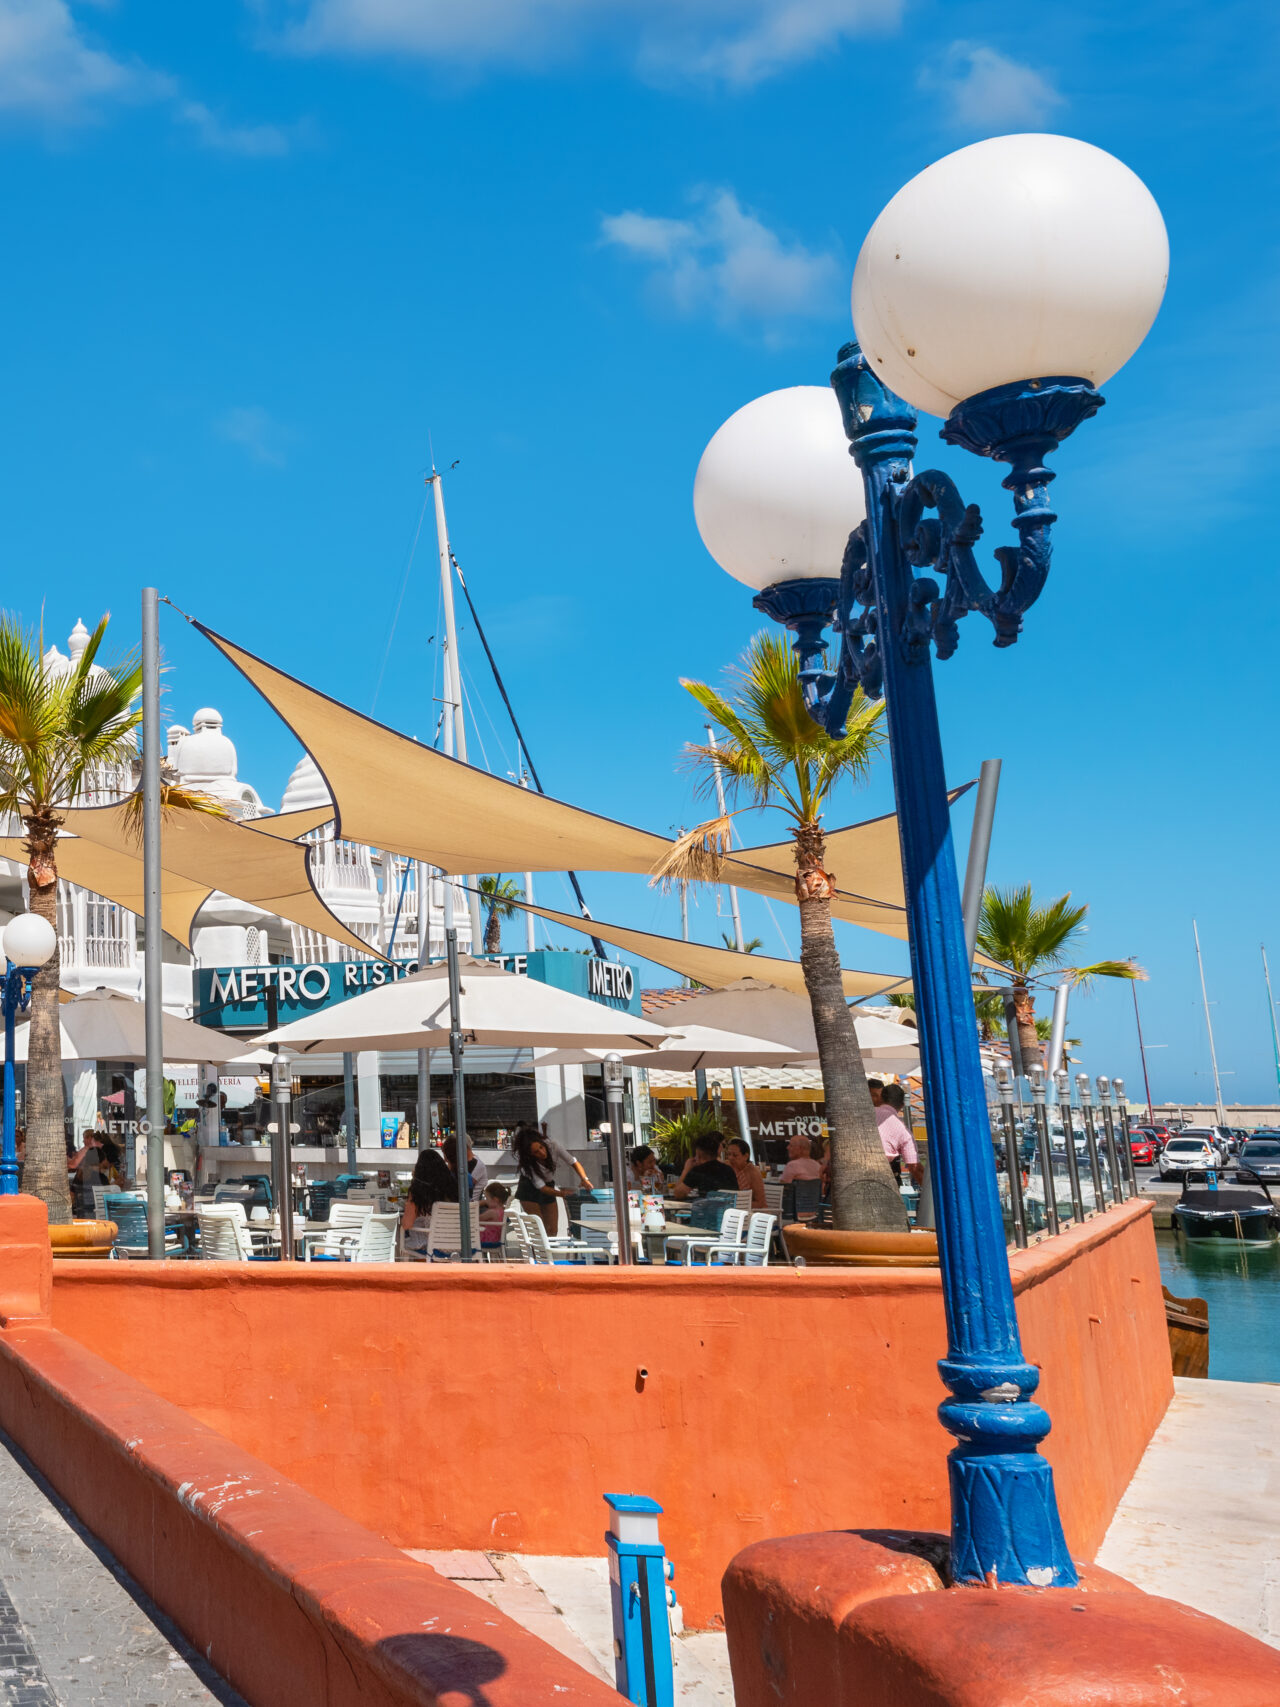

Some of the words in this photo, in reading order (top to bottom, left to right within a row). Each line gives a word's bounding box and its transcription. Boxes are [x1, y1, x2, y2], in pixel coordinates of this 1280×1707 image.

[209, 965, 330, 1004] METRO
[590, 958, 634, 1000] METRO
[94, 1120, 152, 1134] METRO
[759, 1121, 823, 1137] METRO
